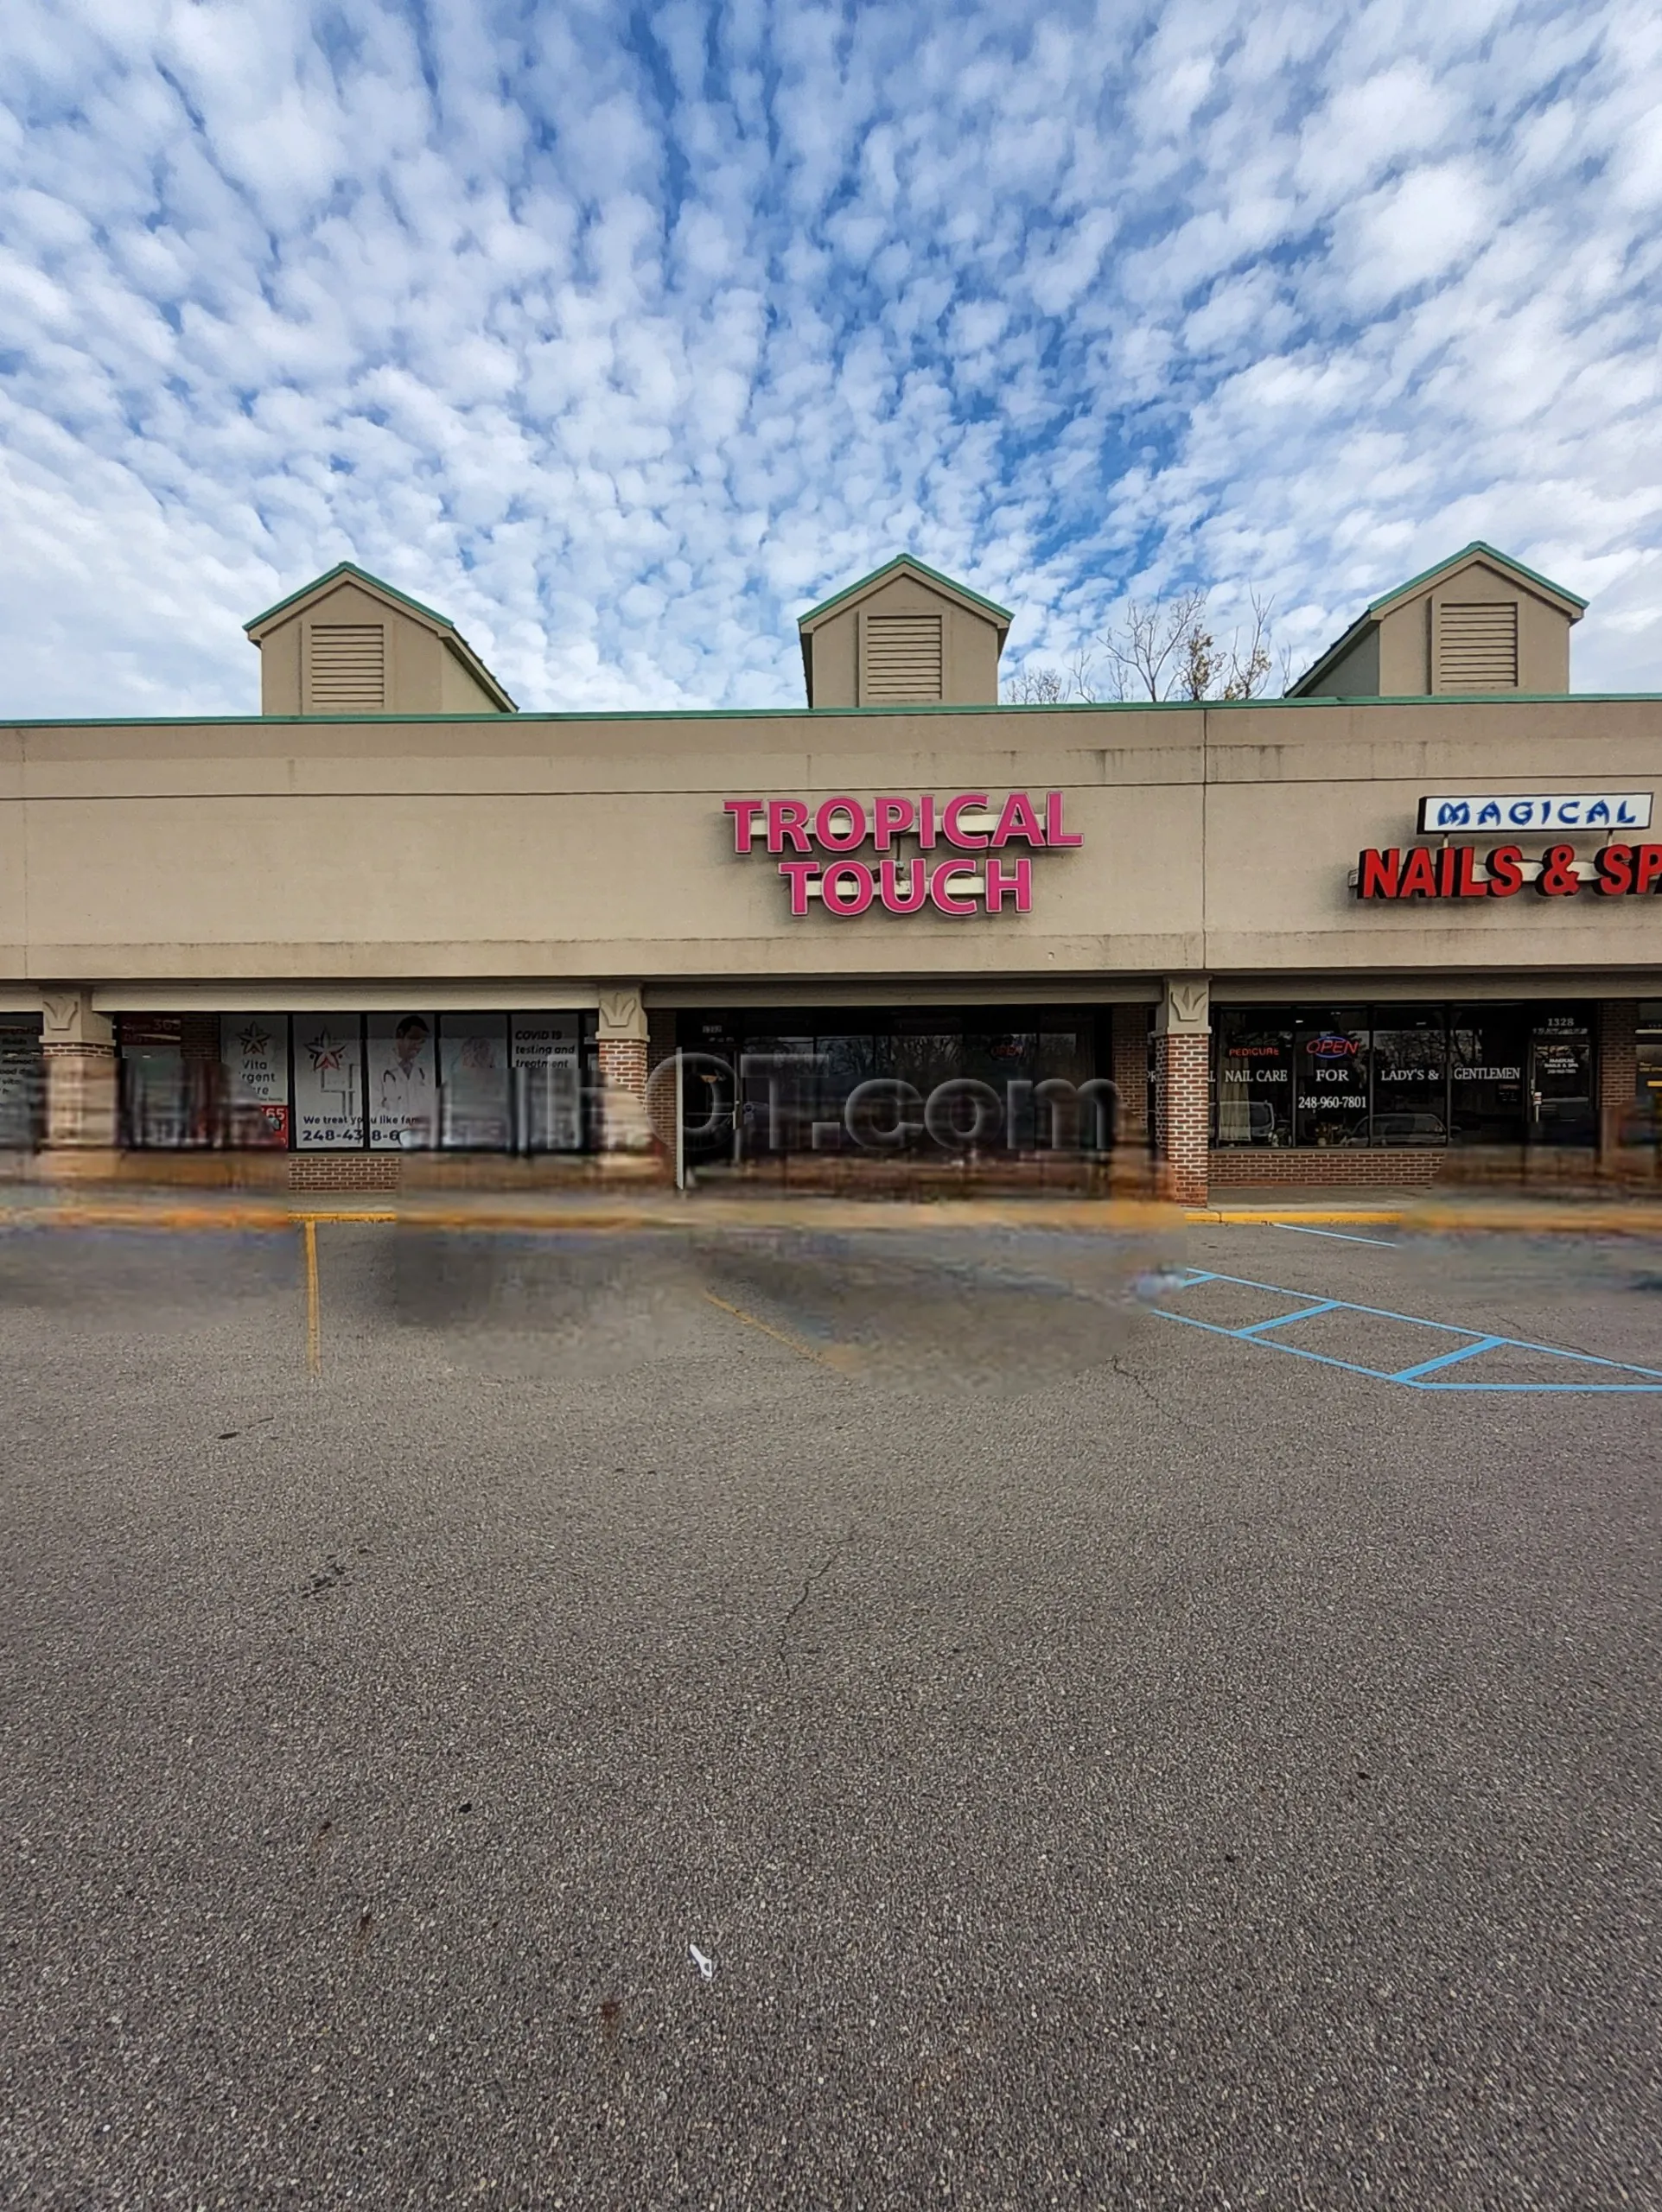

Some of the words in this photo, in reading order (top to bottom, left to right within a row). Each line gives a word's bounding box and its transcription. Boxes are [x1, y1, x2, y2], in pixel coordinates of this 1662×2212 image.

[1436, 800, 1637, 826] MAGICAL
[723, 791, 1084, 853] TROPICAL
[1360, 846, 1523, 899] NAILS
[1540, 845, 1581, 896] &
[1597, 844, 1662, 896] SP
[780, 859, 1032, 916] TOUCH
[1547, 1017, 1575, 1027] 1328
[516, 1030, 549, 1040] COVID
[551, 1030, 563, 1040] 19
[516, 1045, 552, 1056] testing
[554, 1045, 575, 1054] and
[1228, 1046, 1280, 1057] PEDICURE
[1306, 1039, 1359, 1054] OPEN
[243, 1059, 267, 1070] Vita
[239, 1072, 276, 1084] rgent
[1225, 1070, 1253, 1082] NAIL
[1256, 1070, 1288, 1082] CARE
[1315, 1069, 1349, 1082] FOR
[1381, 1068, 1425, 1081] LADY'S
[1427, 1069, 1440, 1081] &
[1454, 1066, 1521, 1080] GENTLEMEN
[1297, 1095, 1367, 1109] 248-960-7801
[262, 1108, 285, 1121] 65
[303, 1116, 321, 1124] We
[323, 1116, 347, 1124] treat
[380, 1115, 398, 1124] like
